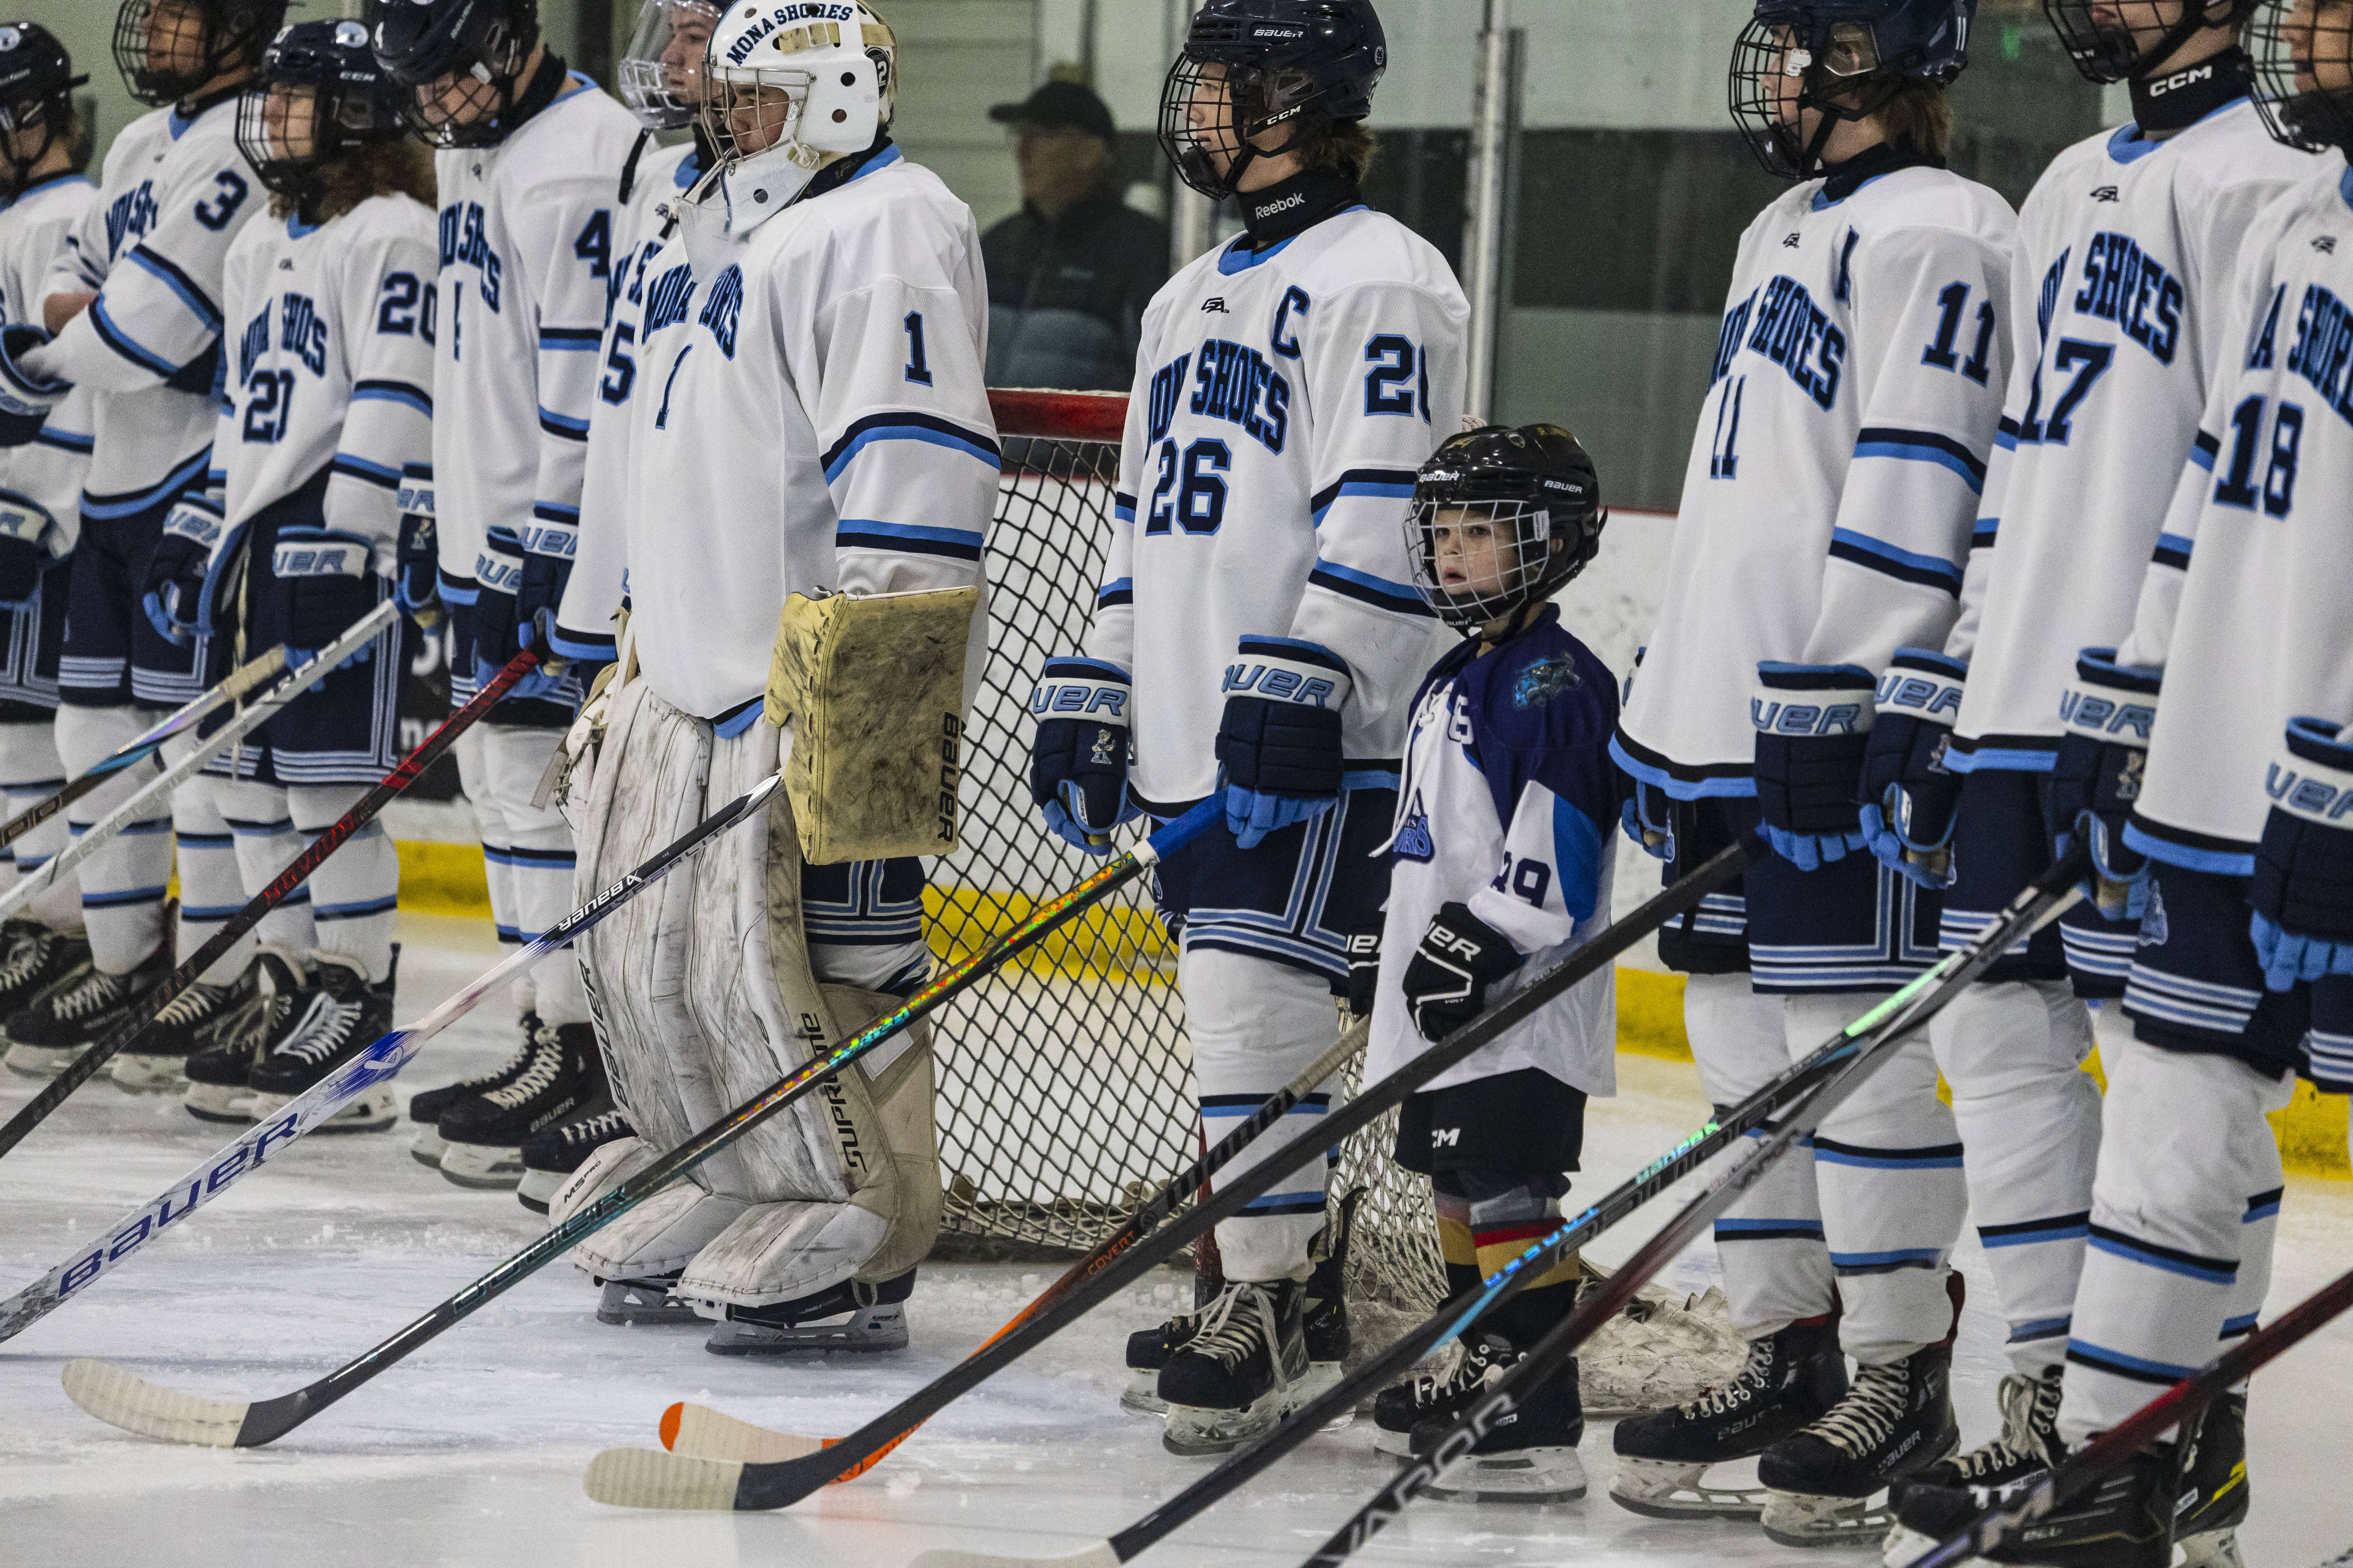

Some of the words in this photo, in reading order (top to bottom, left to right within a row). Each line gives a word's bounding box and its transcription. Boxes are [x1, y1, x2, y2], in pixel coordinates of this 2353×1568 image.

[726, 18, 776, 67] MONA
[1254, 29, 1304, 38] BAUER
[2150, 65, 2212, 97] CCM
[1267, 105, 1301, 125] CCM
[195, 170, 248, 231] 3
[1255, 192, 1306, 221] Reebok
[903, 310, 933, 387] 1
[1271, 285, 1310, 360] C
[1921, 280, 1996, 388] 11
[601, 319, 637, 405] 5
[1146, 436, 1232, 536] 26
[1419, 473, 1460, 483] BAUER
[1545, 480, 1582, 494] BAUER
[2213, 393, 2306, 521] 18
[937, 706, 960, 843] BAUER
[558, 879, 625, 931] BAUER
[578, 958, 631, 1111] BAUER
[59, 1113, 298, 1298] BAUER
[1088, 1230, 1135, 1275] COVERT
